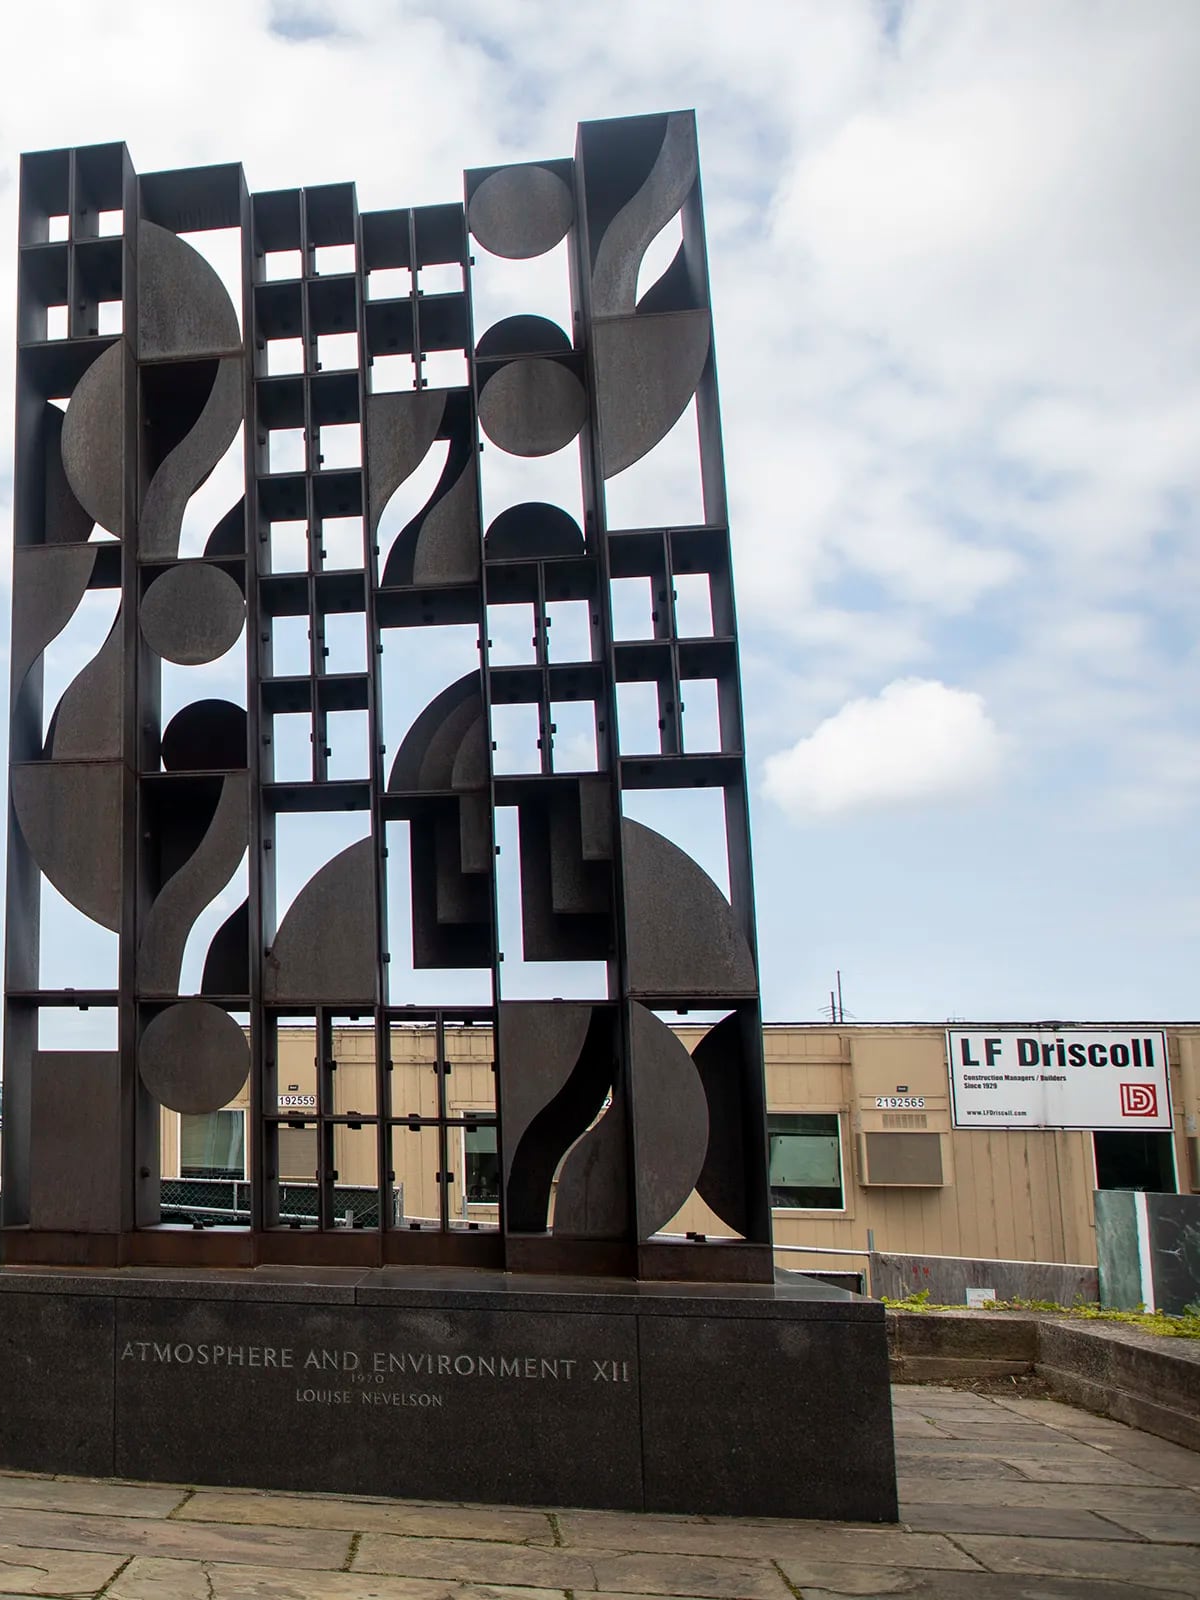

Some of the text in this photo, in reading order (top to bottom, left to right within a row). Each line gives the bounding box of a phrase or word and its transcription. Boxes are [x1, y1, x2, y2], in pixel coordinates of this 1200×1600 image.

[1016, 1038, 1155, 1067] Driscoll
[963, 1074, 1003, 1082] Construction
[1004, 1074, 1036, 1083] Managers
[280, 1096, 315, 1106] 192559
[876, 1097, 925, 1108] 2192565
[966, 1109, 1027, 1117] www.LFDriscoll.com
[120, 1341, 630, 1382] ATMOSPHERE AND ENVIRONMENT XII
[350, 1373, 384, 1384] 1970
[296, 1388, 443, 1407] LOUISE NEVELSON
